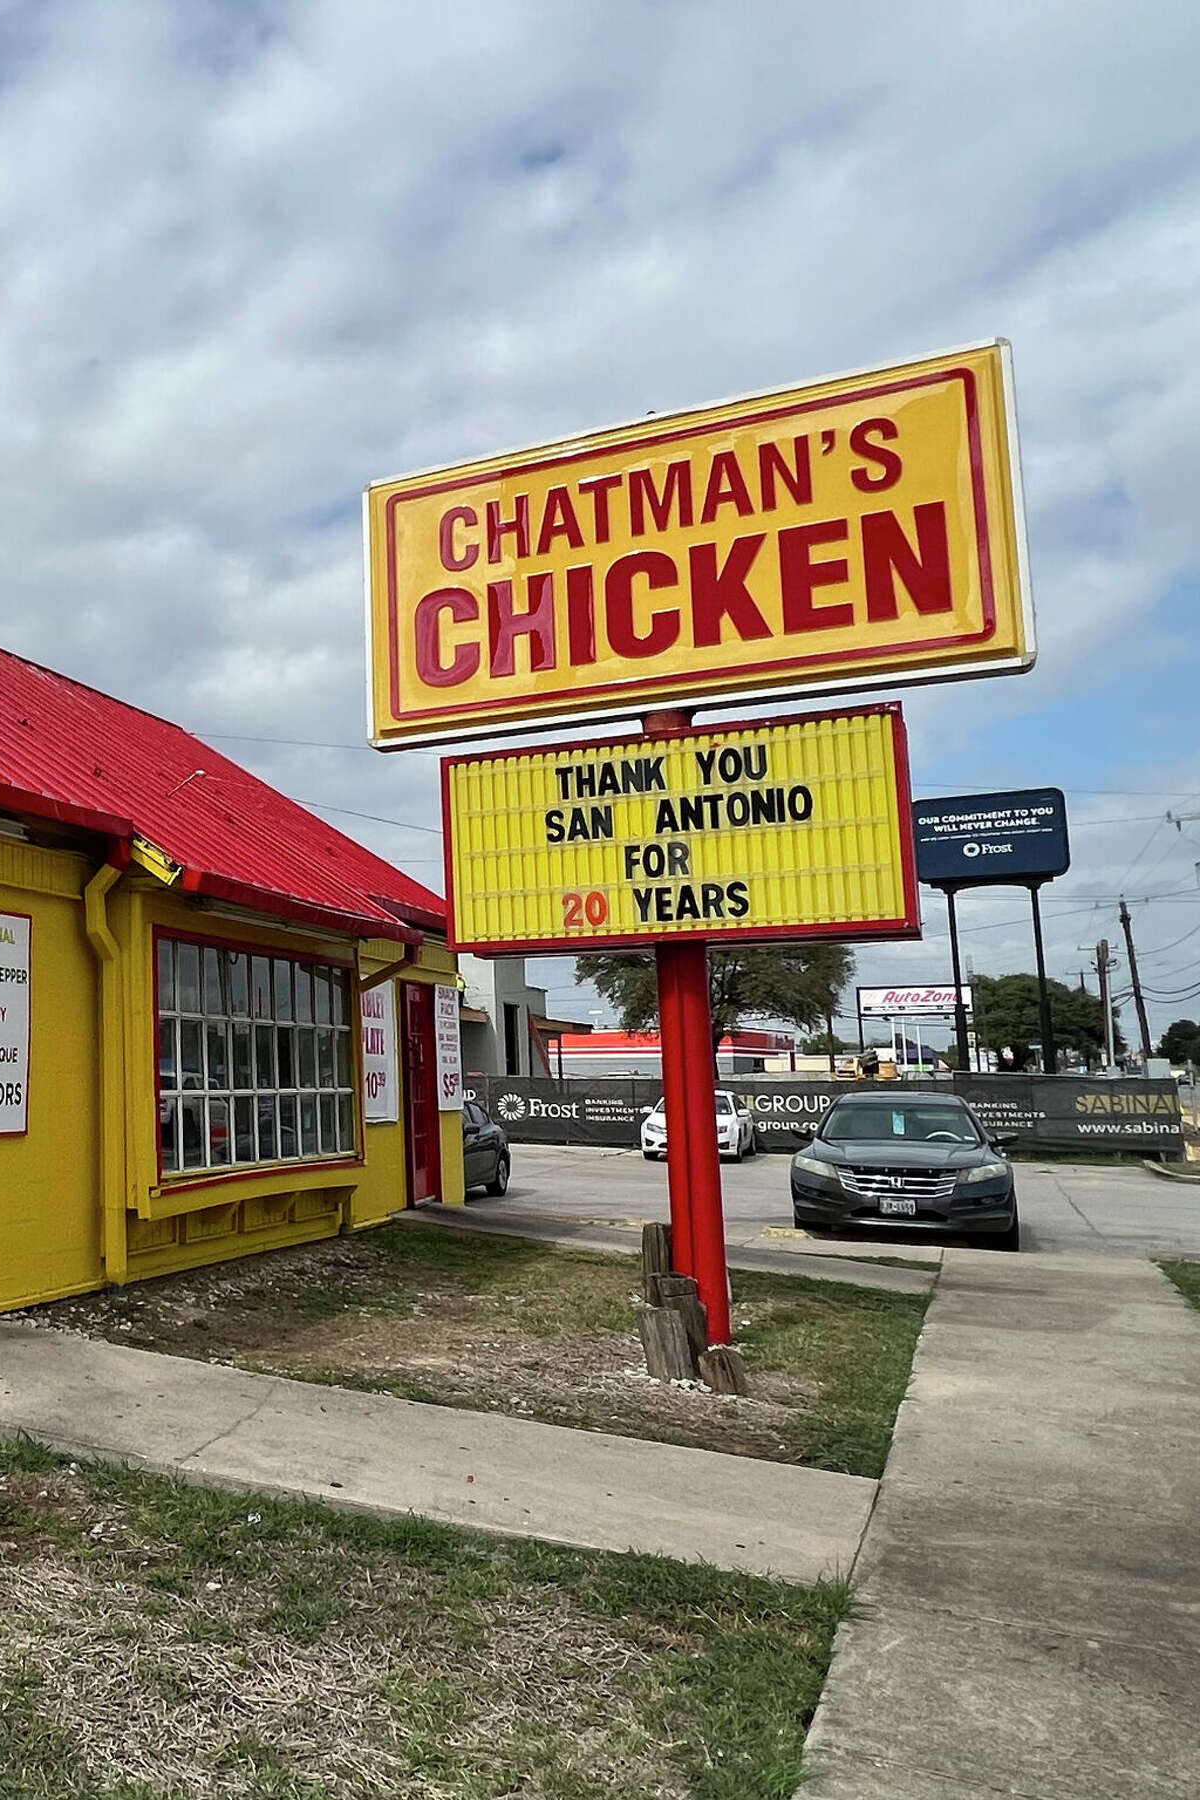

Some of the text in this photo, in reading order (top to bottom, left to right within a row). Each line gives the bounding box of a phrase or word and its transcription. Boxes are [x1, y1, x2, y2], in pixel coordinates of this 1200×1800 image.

[438, 417, 902, 572] CHATMAN'S
[413, 500, 953, 688] CHICKEN
[555, 744, 769, 801] THANK YOU
[545, 784, 813, 843] SAN ANTONIO
[918, 806, 1054, 825] OUR COMMITMENT TO YOU
[933, 817, 1041, 832] WILL NEVER CHANGE.
[981, 844, 1013, 855] Frost
[625, 842, 691, 880] FOR
[562, 881, 750, 928] 20 YEARS
[528, 1098, 580, 1118] Frost
[755, 1095, 830, 1112] GROUP
[974, 1111, 1046, 1119] NVESTMENTS
[982, 1120, 1034, 1128] SURANCE
